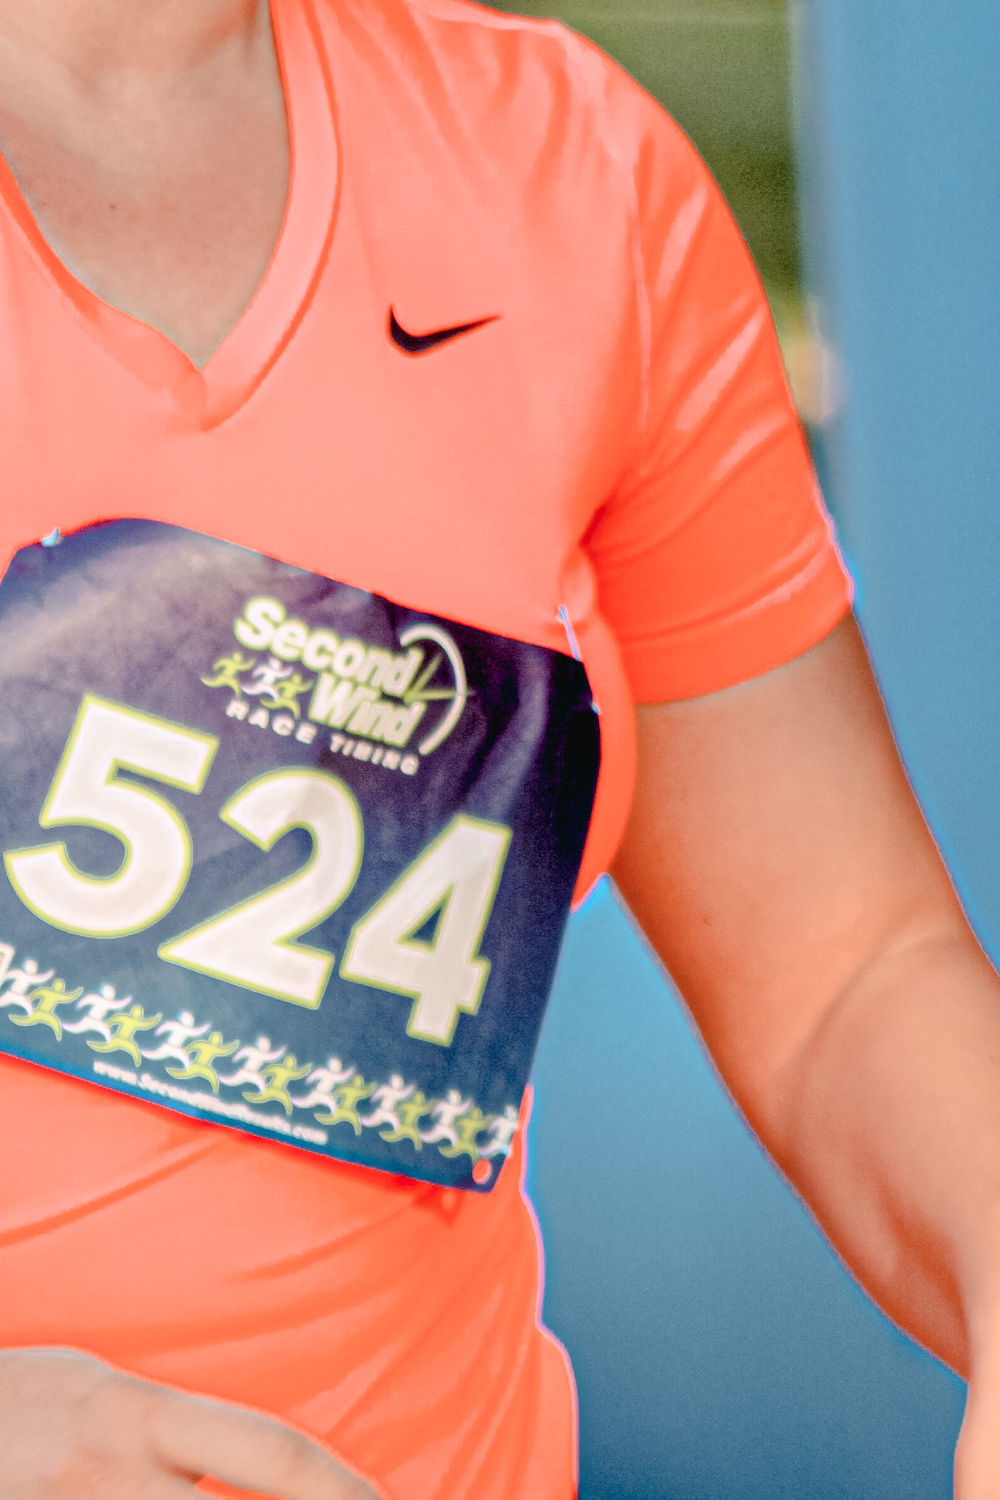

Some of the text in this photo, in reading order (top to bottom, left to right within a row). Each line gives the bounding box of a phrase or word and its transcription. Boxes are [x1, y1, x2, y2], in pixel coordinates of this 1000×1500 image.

[234, 597, 423, 697] Second
[226, 701, 420, 775] RACE TIMING
[309, 672, 426, 747] Wind
[3, 694, 513, 1047] 524
